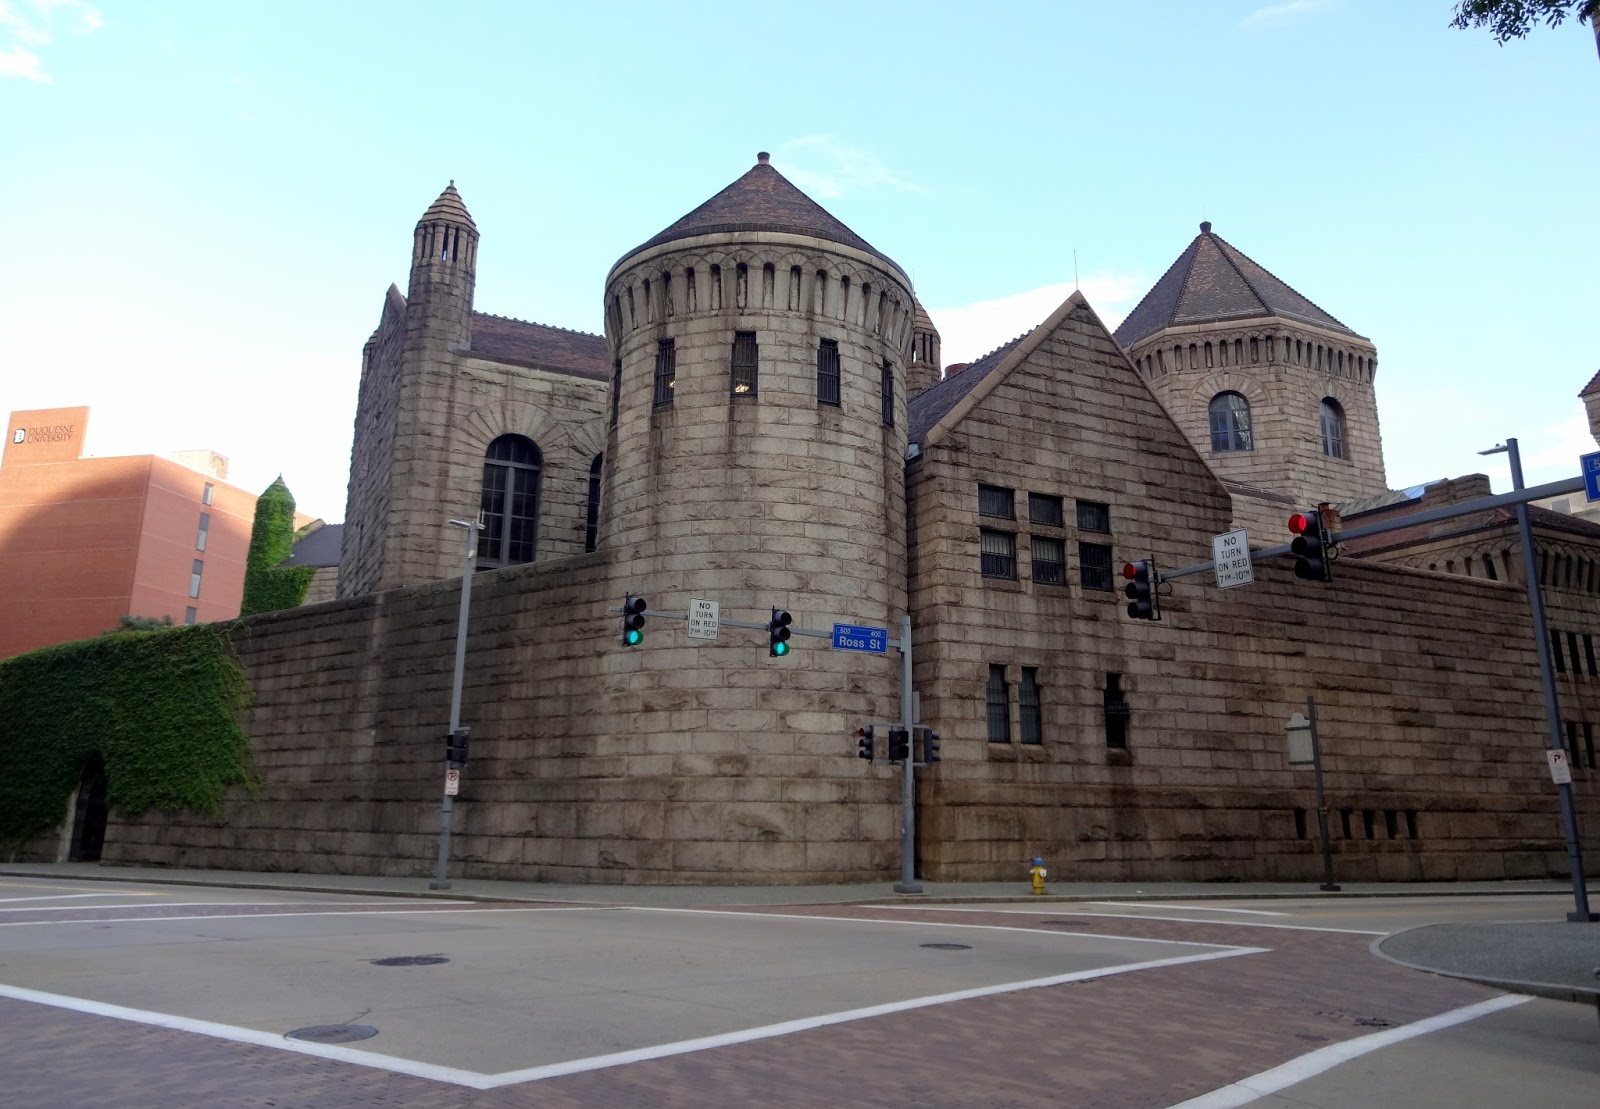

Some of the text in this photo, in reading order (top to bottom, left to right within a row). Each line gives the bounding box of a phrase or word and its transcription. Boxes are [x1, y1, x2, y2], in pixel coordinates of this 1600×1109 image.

[28, 424, 74, 436] DUQUESNE
[27, 433, 73, 444] UNIVERSITY
[1223, 536, 1236, 547] NO
[1221, 547, 1242, 560] TURN
[1218, 558, 1247, 572] ON RED
[699, 602, 711, 610] NO
[695, 610, 714, 619] TURN
[690, 619, 717, 628] ON RED
[839, 636, 881, 650] Ross St
